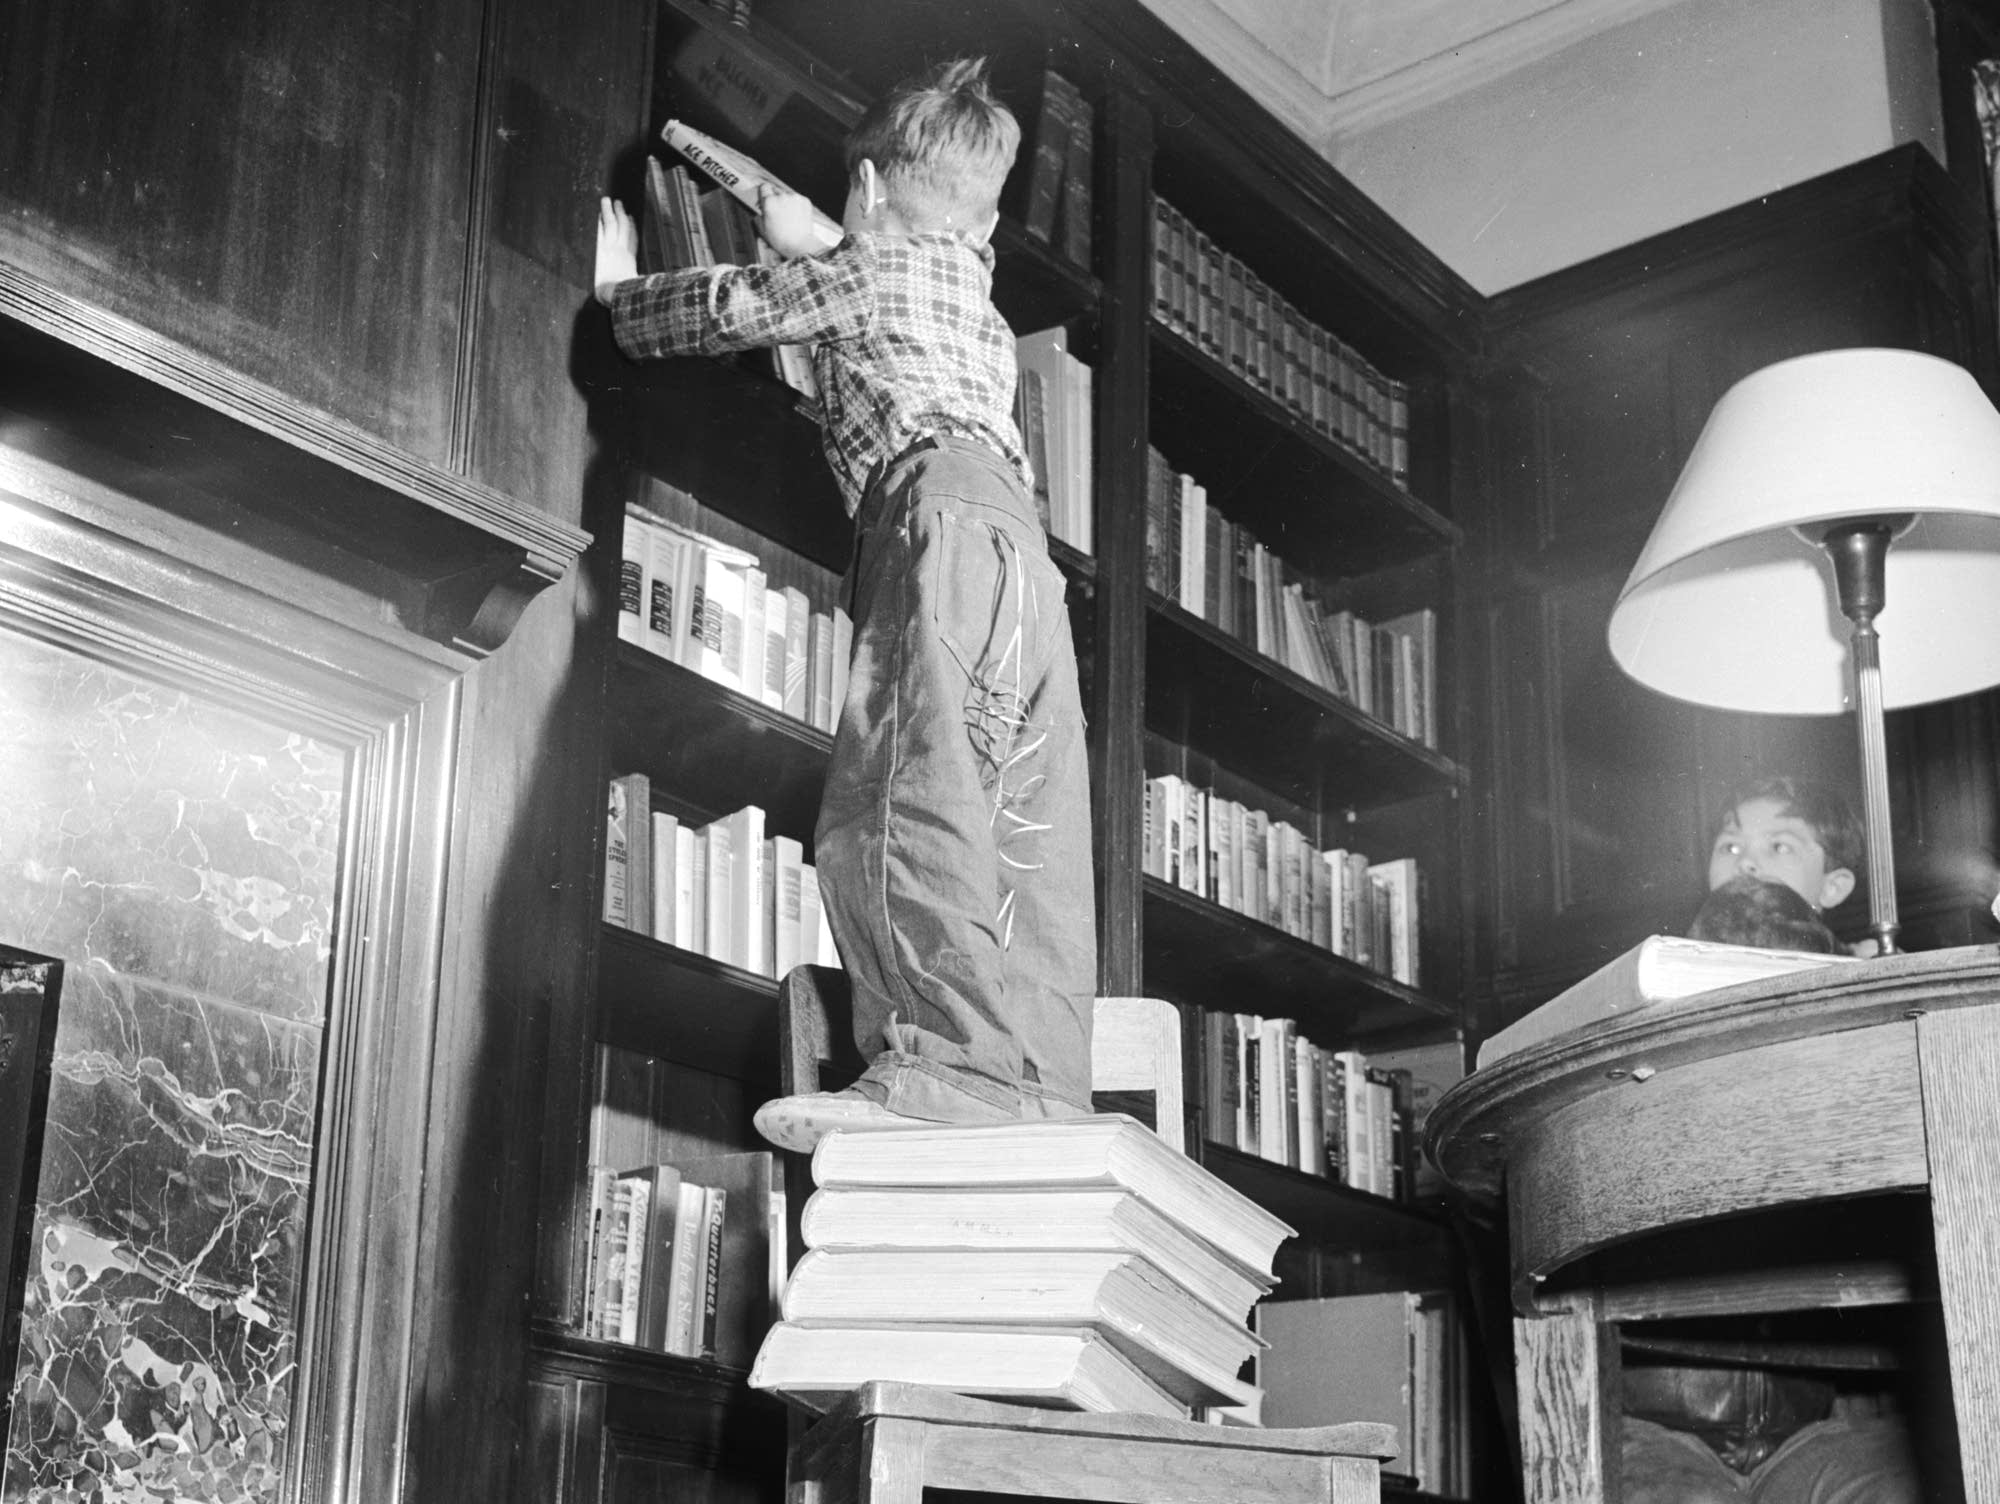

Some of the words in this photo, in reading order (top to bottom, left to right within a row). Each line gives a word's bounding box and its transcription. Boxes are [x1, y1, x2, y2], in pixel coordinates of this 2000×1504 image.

[683, 143, 704, 161] ACE
[702, 156, 740, 188] PITCHER
[626, 1263, 642, 1313] YEAR
